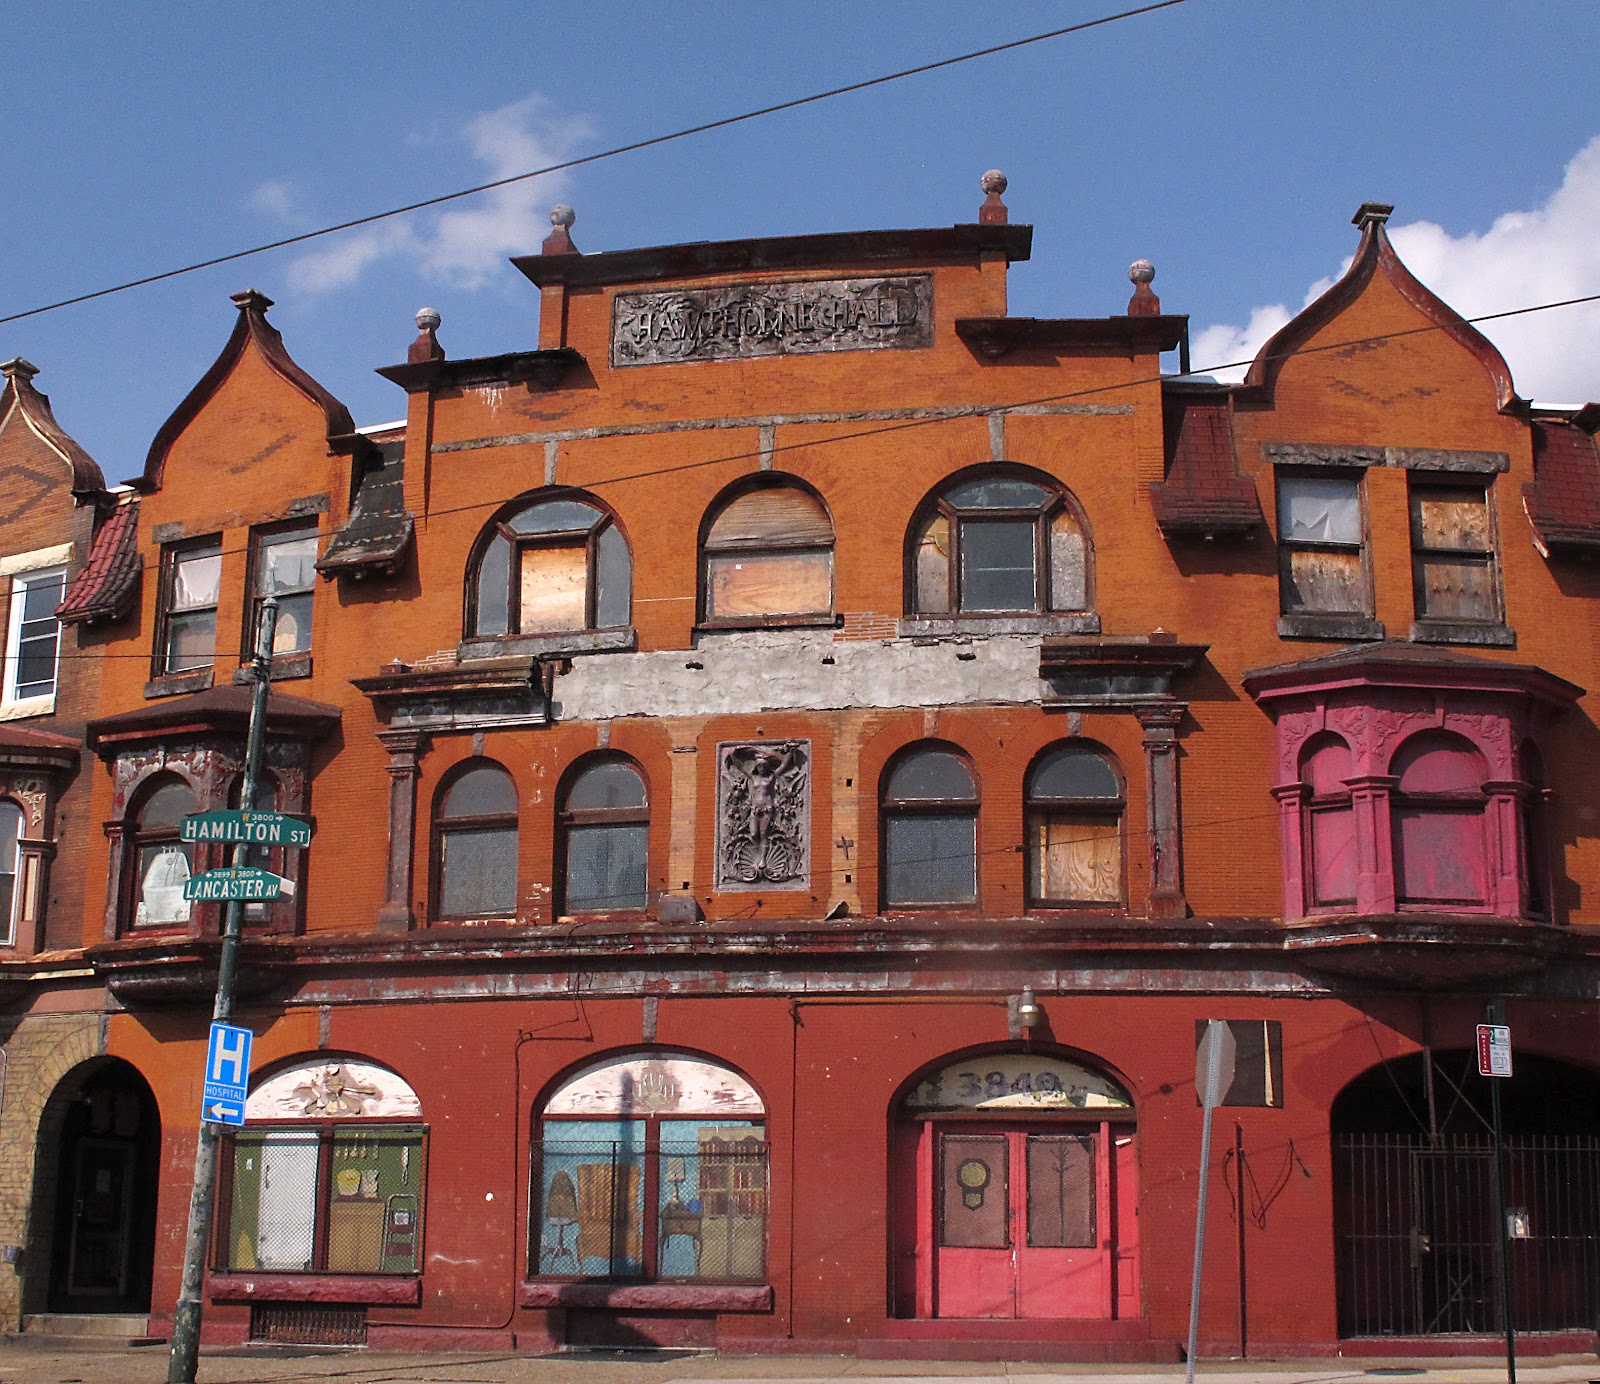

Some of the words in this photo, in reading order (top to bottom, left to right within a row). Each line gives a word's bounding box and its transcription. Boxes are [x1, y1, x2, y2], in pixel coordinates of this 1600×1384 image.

[828, 298, 916, 331] HALL
[242, 813, 250, 821] W
[186, 820, 281, 841] HAMILTON
[290, 830, 306, 843] ST
[237, 870, 255, 878] 3800
[186, 880, 264, 899] LANCASTER
[265, 884, 279, 897] AV
[213, 1029, 245, 1083] H
[206, 1086, 243, 1100] HOSPITAL
